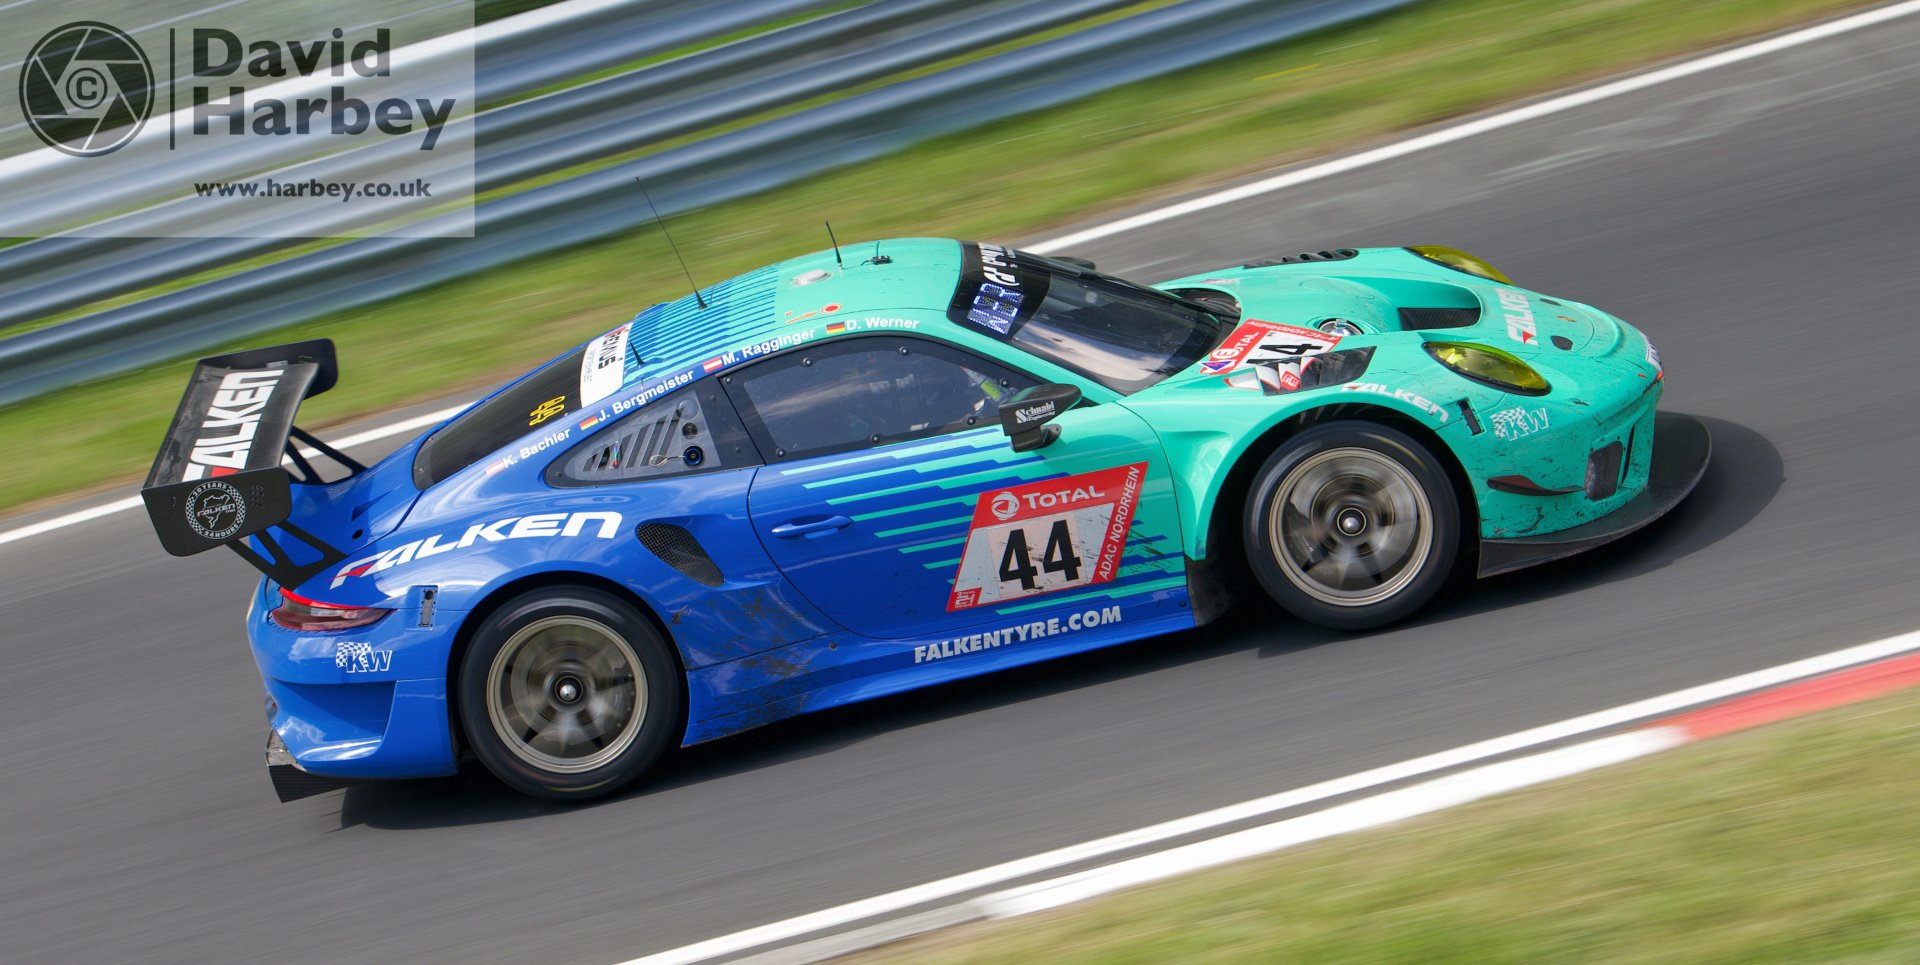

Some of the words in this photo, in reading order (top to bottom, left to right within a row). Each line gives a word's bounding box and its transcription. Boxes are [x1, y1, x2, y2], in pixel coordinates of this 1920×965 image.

[723, 352, 740, 366] M.
[742, 328, 816, 361] Ragginger
[846, 318, 863, 332] D.
[865, 316, 920, 330] Werner
[597, 410, 611, 422] J.
[612, 370, 694, 414] Bergmeister
[1340, 382, 1450, 424] FALKEN
[502, 454, 518, 469] K.
[520, 428, 571, 459] Bachler
[1022, 485, 1105, 511] TOTAL
[1099, 544, 1117, 580] ADAC
[1112, 466, 1140, 542] NORDRHEIN
[327, 511, 623, 590] FALKEN
[999, 519, 1083, 591] 44
[914, 605, 1122, 664] FALKENTYRE.COM
